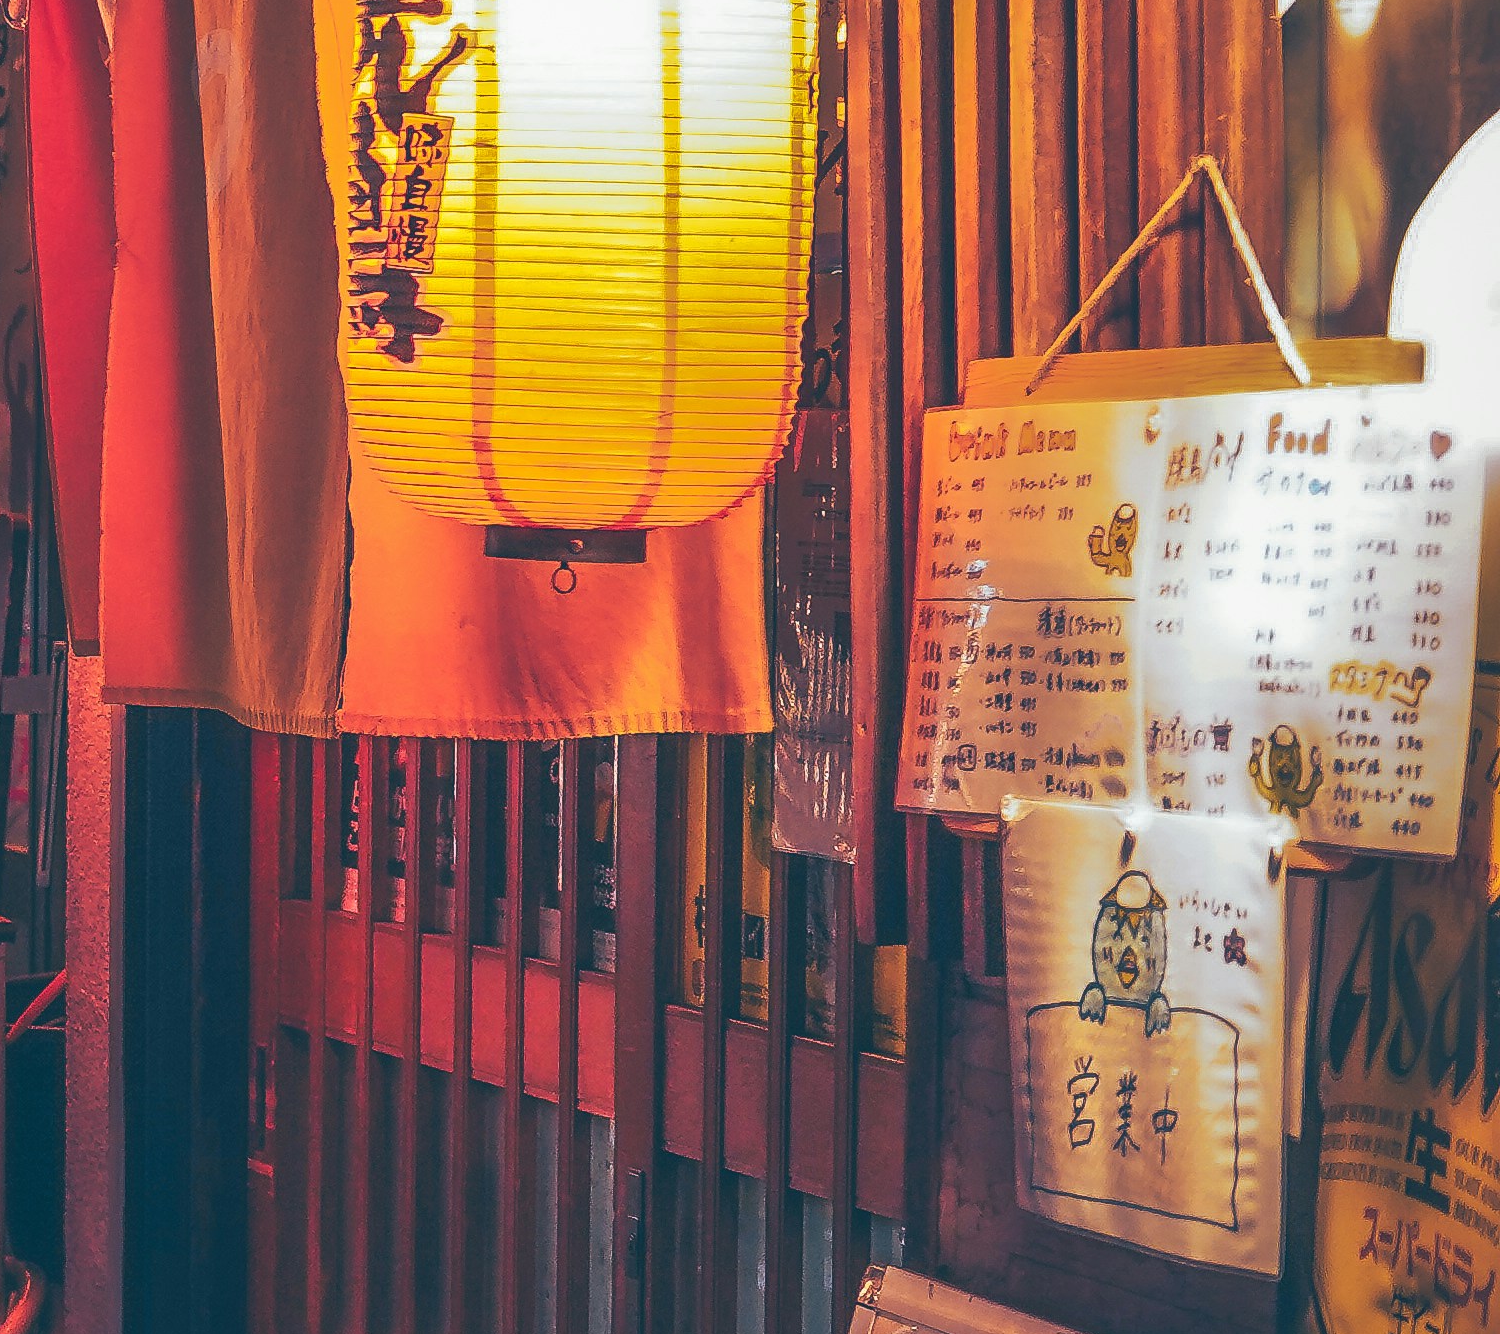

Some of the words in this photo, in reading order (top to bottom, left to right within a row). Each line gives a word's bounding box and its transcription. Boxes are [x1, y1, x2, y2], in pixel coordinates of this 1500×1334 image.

[1267, 412, 1332, 456] Food
[1066, 1055, 1179, 1167] 営業中
[1358, 1205, 1497, 1329] スーパードライ
